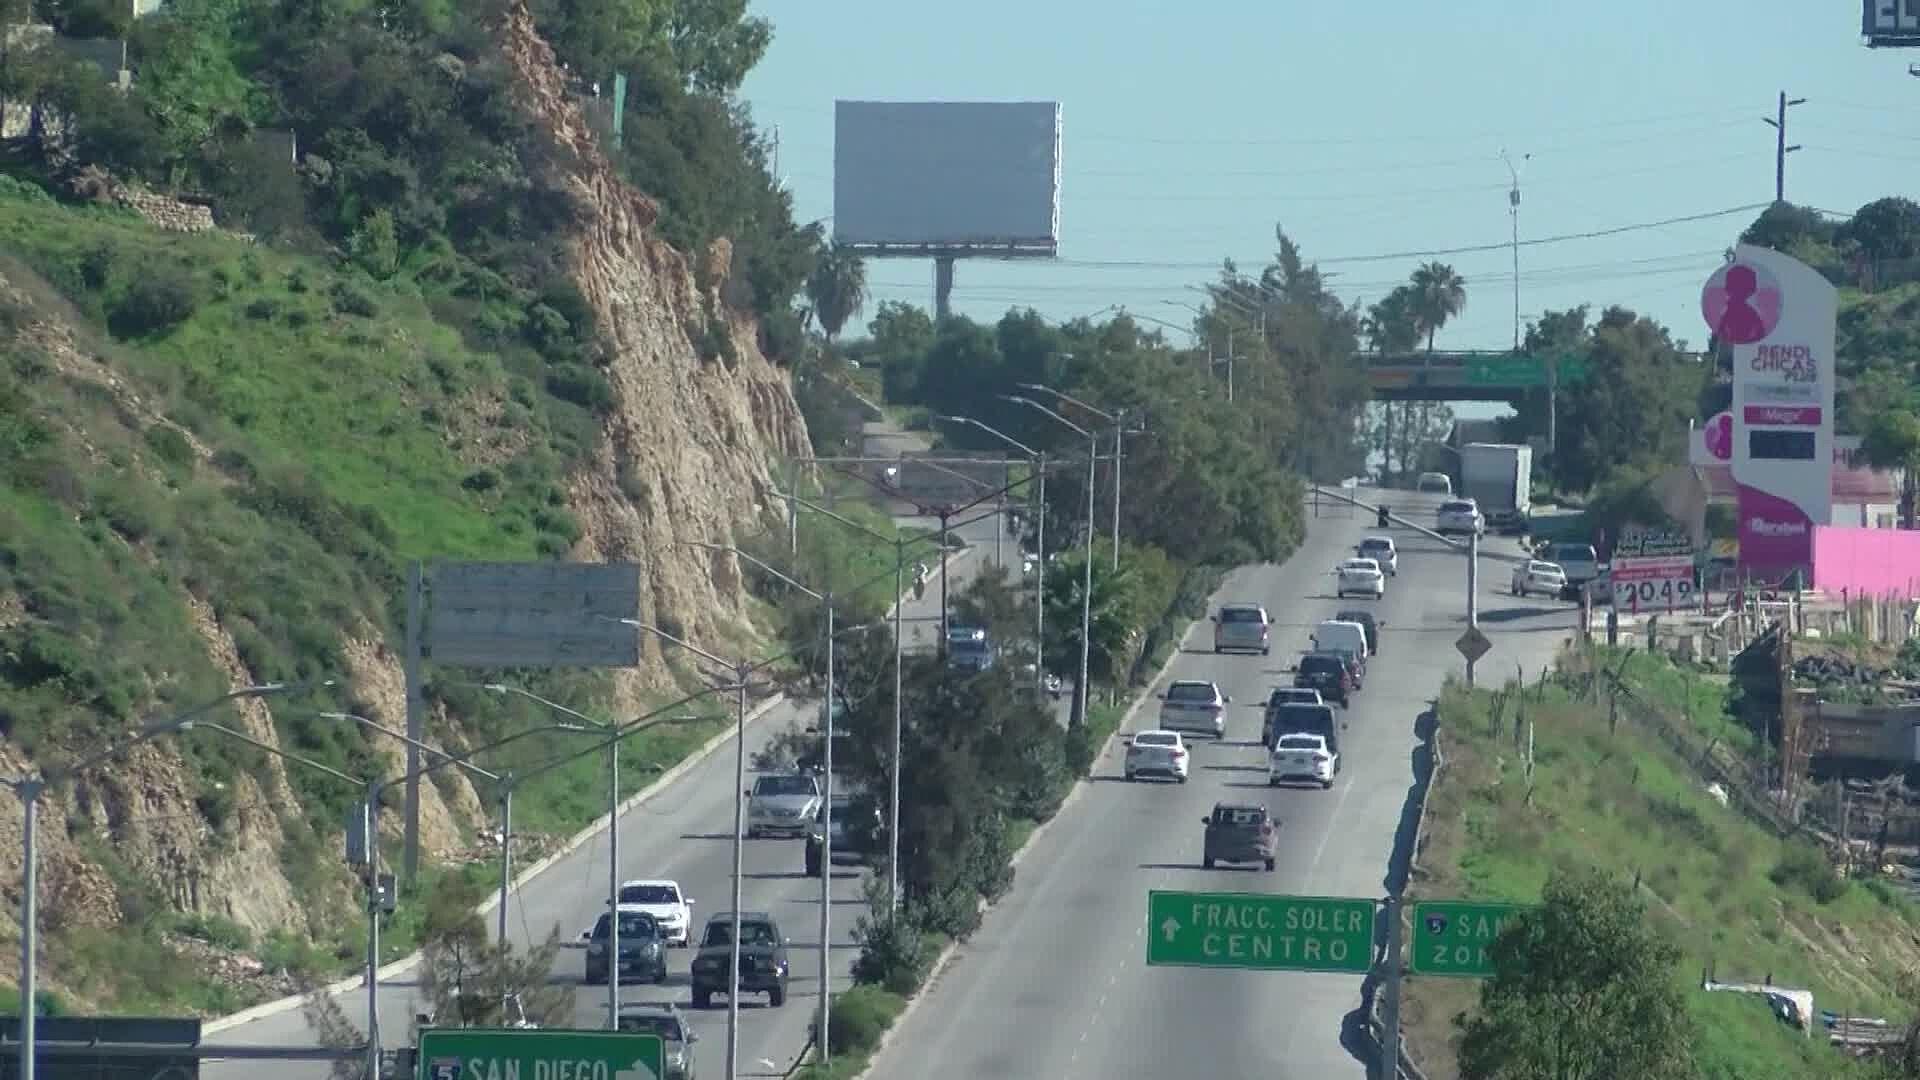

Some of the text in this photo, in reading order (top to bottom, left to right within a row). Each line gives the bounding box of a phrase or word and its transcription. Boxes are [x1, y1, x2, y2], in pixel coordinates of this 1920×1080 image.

[1758, 345, 1809, 359] RENDI
[1752, 358, 1817, 371] CHICAS
[1192, 903, 1363, 932] FRACC. SOLER
[1203, 932, 1348, 961] CENTRO
[469, 1058, 520, 1080] SAN
[535, 1058, 608, 1080] DIEGO
